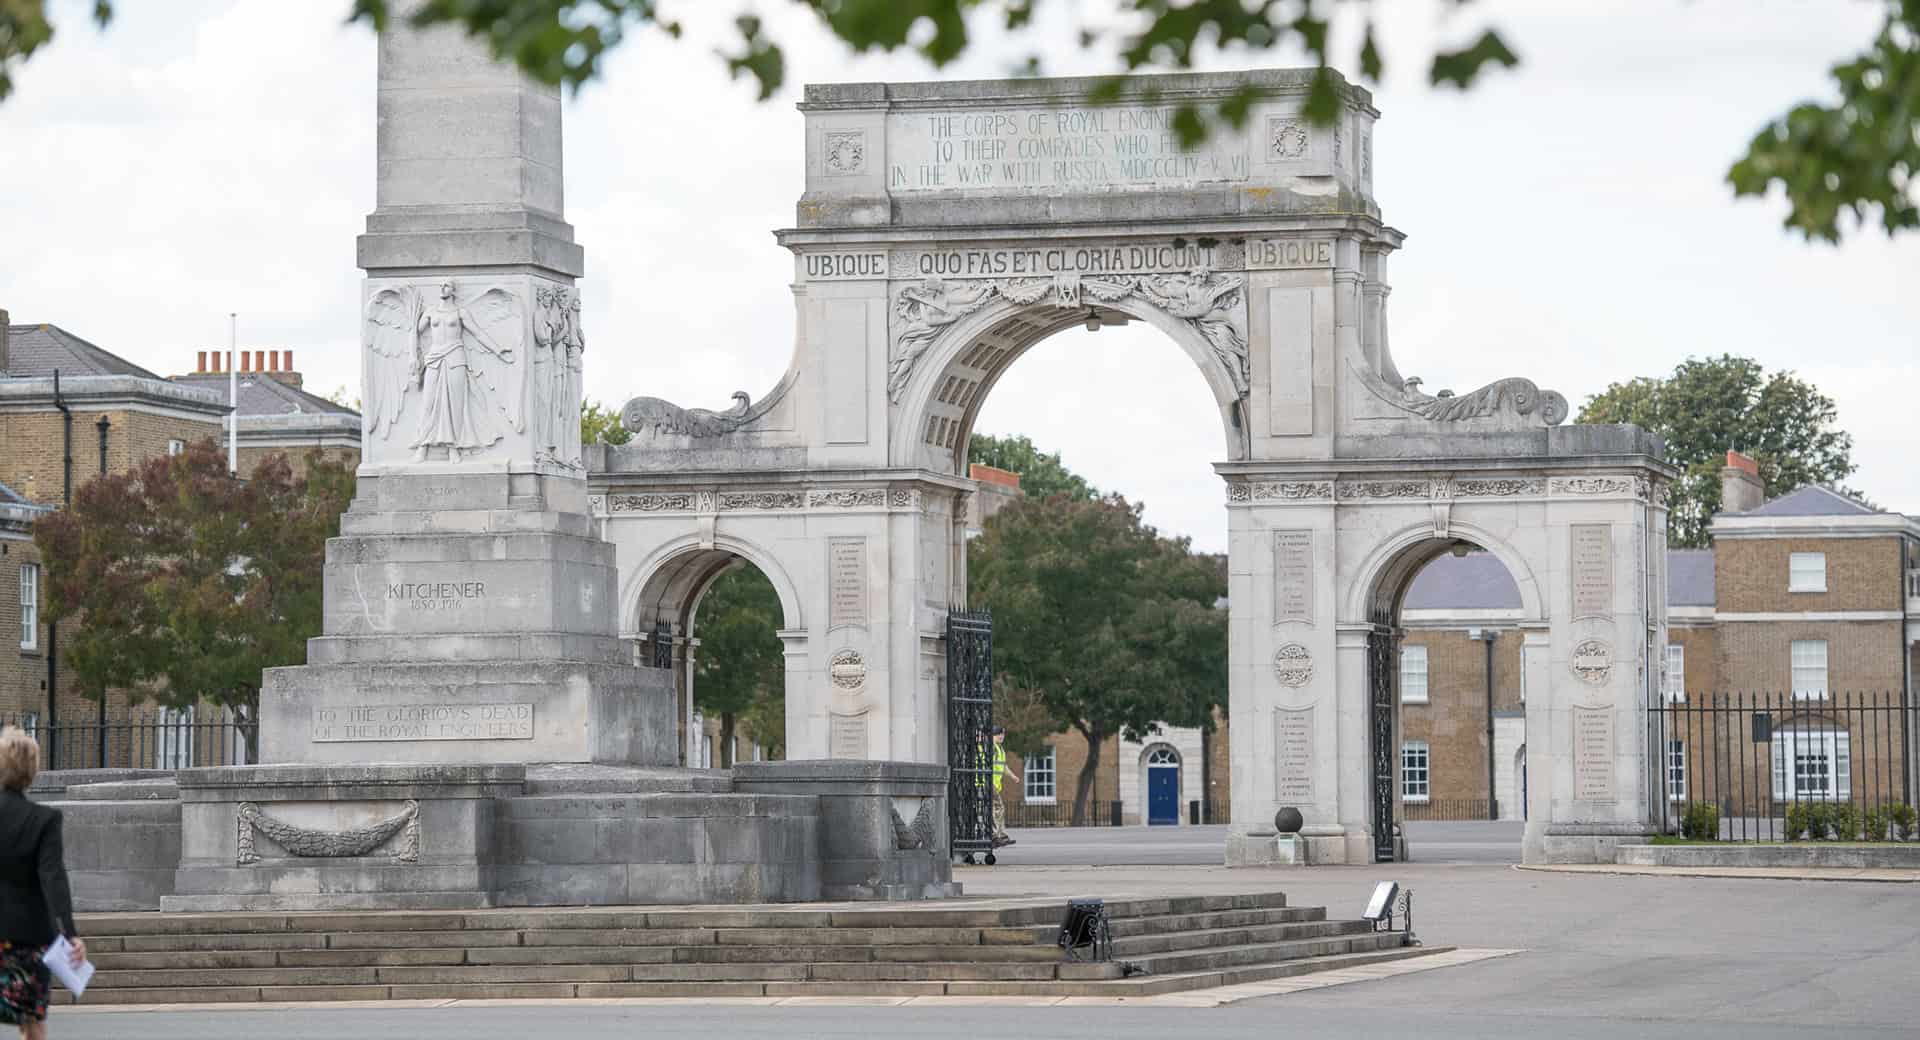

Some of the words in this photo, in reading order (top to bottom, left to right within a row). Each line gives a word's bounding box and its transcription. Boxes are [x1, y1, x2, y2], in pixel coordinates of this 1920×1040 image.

[928, 116, 961, 136] THE
[964, 114, 1018, 136] CORPS
[1028, 113, 1049, 134] OF
[1058, 112, 1108, 133] ROYAL
[933, 140, 953, 162] TO
[962, 139, 1007, 161] THEIR
[1018, 136, 1104, 159] COMRADES
[1114, 135, 1148, 155] WHO
[1160, 134, 1200, 154] FEL
[891, 165, 907, 186] IN
[920, 163, 945, 186] THE
[957, 163, 992, 184] WAR
[1002, 161, 1041, 184] WITH
[1053, 159, 1112, 182] RUSSIA
[806, 254, 885, 276] UBIQUE
[919, 253, 962, 275] QUO
[967, 252, 1007, 274] FAS
[1012, 251, 1041, 273] ET
[1250, 242, 1331, 265] UBIQUE
[388, 582, 487, 600] KITCHENER
[318, 710, 337, 722] TO
[347, 708, 377, 722] THE
[480, 705, 529, 720] DEAD
[314, 726, 337, 738] OF
[344, 725, 375, 738] THE
[379, 724, 432, 737] ROYAL
[440, 722, 529, 737] ENGINEERS
